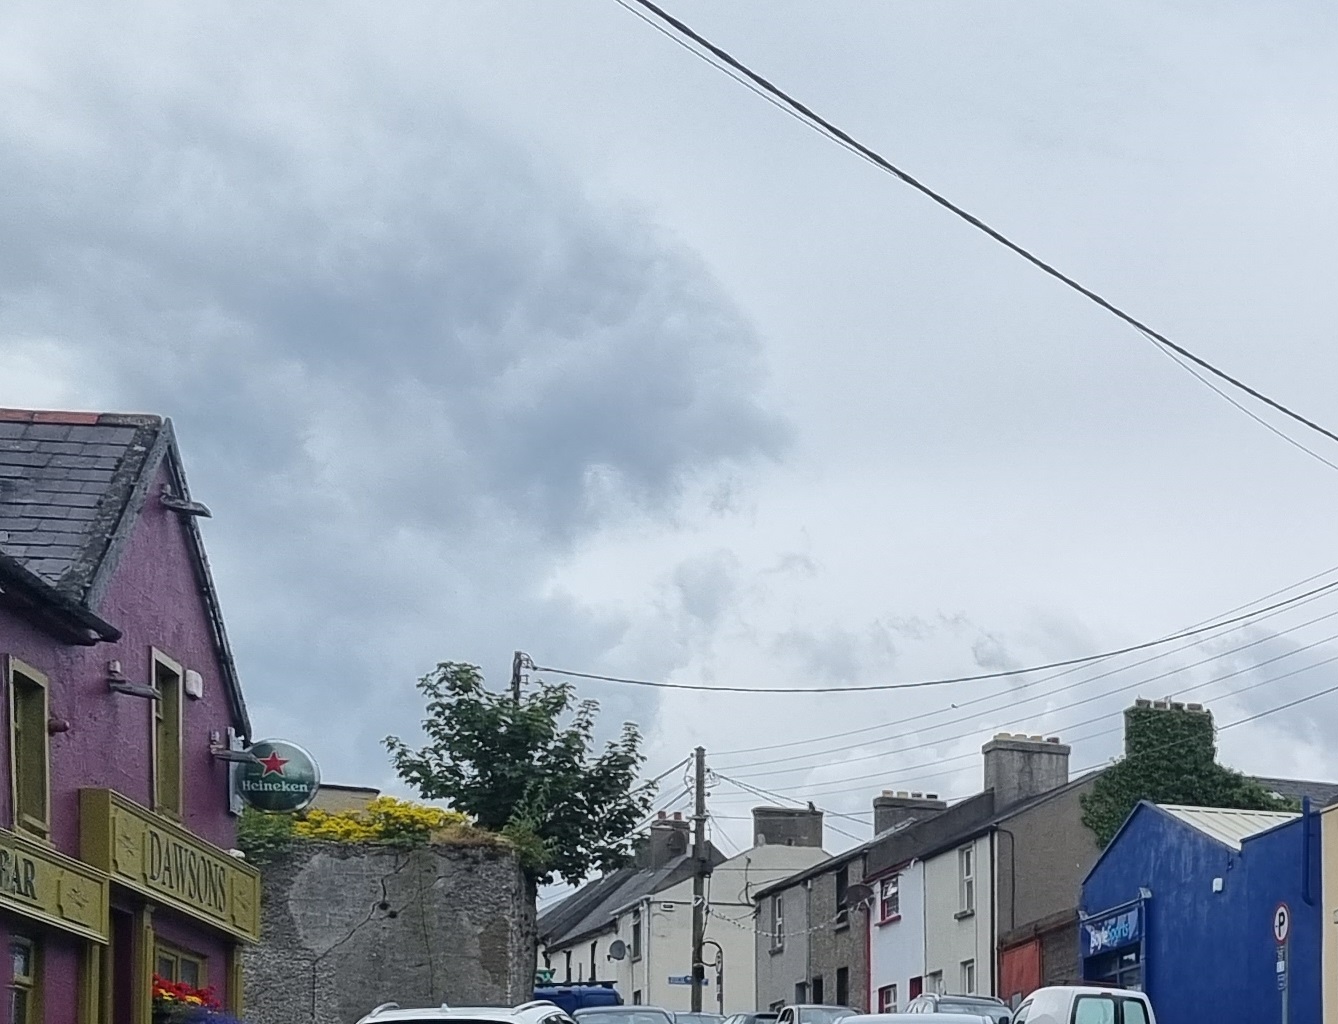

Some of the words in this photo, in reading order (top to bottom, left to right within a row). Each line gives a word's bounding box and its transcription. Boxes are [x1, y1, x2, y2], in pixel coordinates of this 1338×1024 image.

[241, 779, 310, 793] Heineken
[149, 830, 227, 913] DAWSONS
[1278, 911, 1286, 938] P
